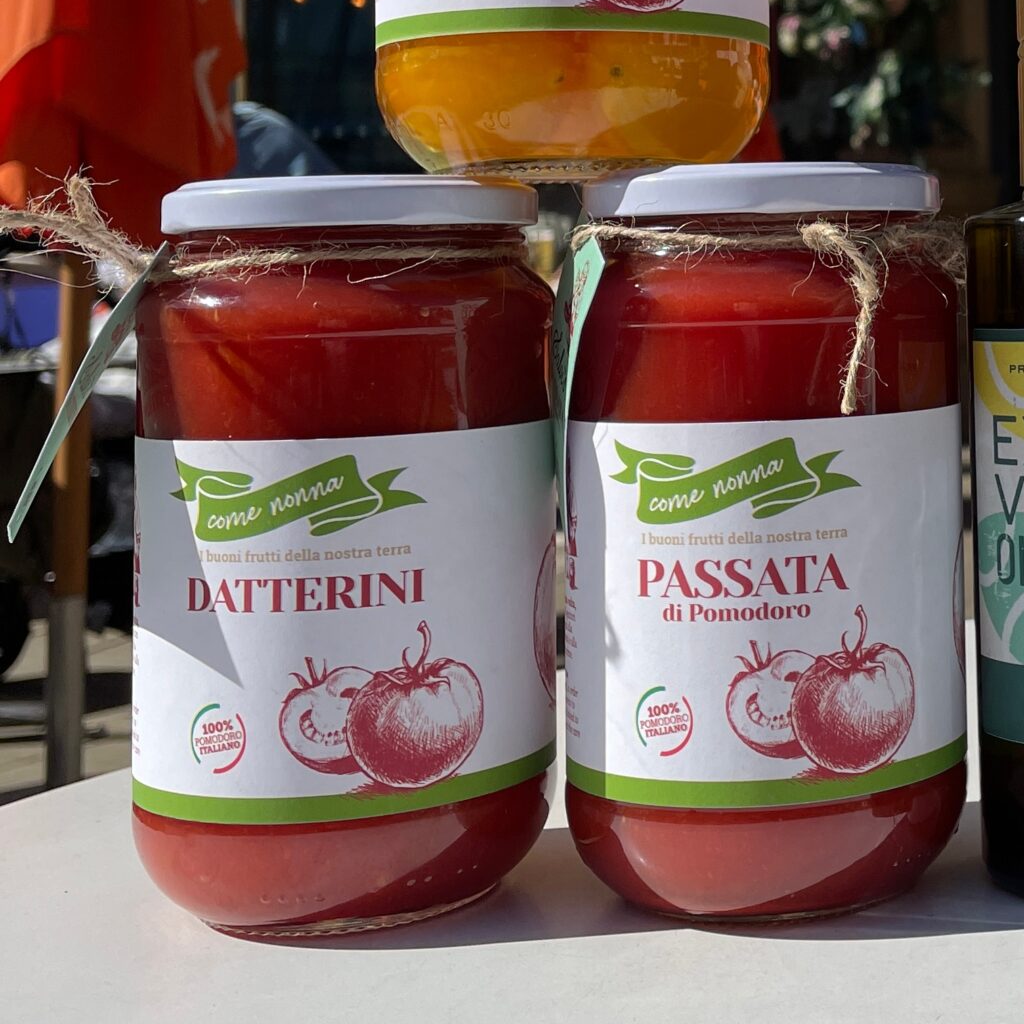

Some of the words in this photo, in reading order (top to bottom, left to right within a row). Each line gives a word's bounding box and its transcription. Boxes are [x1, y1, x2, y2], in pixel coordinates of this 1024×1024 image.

[649, 489, 705, 513] come
[713, 458, 784, 499] nonna
[207, 506, 263, 529] come
[269, 476, 345, 516] nonna
[641, 533, 647, 545] I
[648, 532, 685, 546] buoni
[688, 532, 724, 546] frutti
[728, 531, 763, 545] della
[766, 531, 812, 544] nostra
[816, 528, 849, 541] terra
[206, 549, 242, 563] buoni
[244, 548, 281, 563] frutti
[284, 548, 320, 562] della
[324, 547, 372, 561] nostra
[376, 544, 412, 556] terra
[637, 553, 850, 598] PASSATA
[187, 568, 425, 613] DATTERINI
[662, 604, 682, 622] di
[689, 602, 811, 622] Pomodoro
[648, 702, 680, 717] 100%
[202, 719, 234, 735] 100%
[640, 713, 689, 729] POMODORO
[195, 731, 242, 746] POMODORO
[645, 724, 687, 738] ITALIANO
[199, 741, 241, 755] ITALIANO
